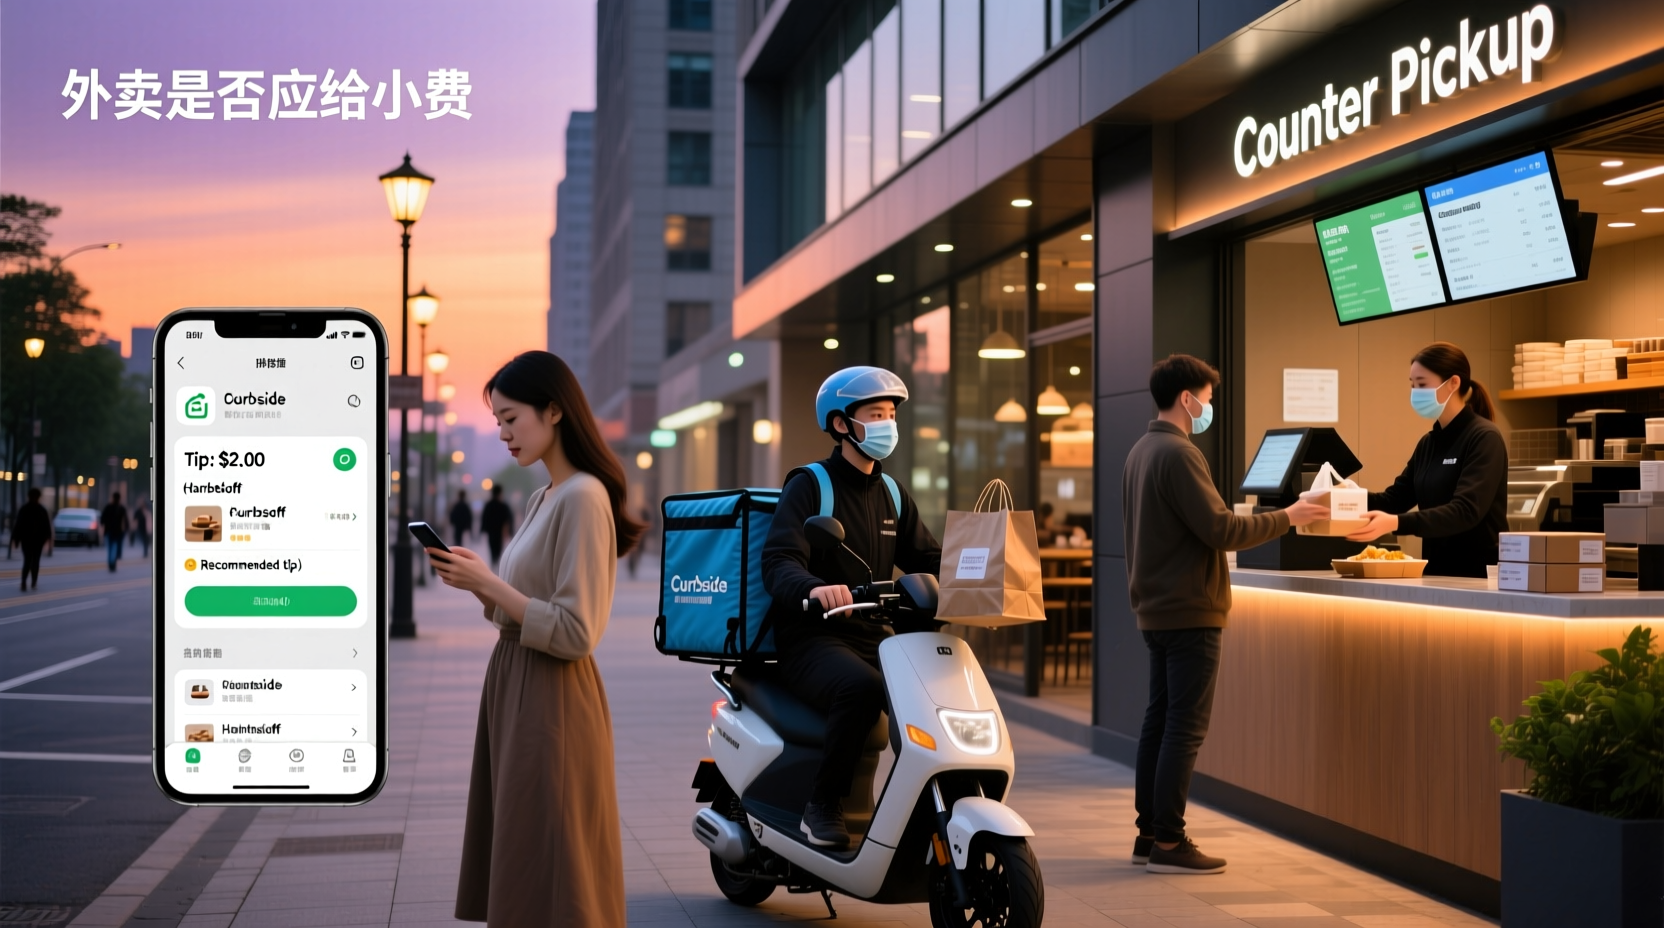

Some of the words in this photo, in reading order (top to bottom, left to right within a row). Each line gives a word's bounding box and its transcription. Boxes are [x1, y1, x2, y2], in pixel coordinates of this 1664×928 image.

[1234, 76, 1379, 178] Counter
[1391, 4, 1555, 117] Pickup
[184, 451, 214, 470] Tip:
[218, 450, 265, 468] $2.00
[201, 559, 279, 570] Recommended
[671, 575, 728, 593] Curbside
